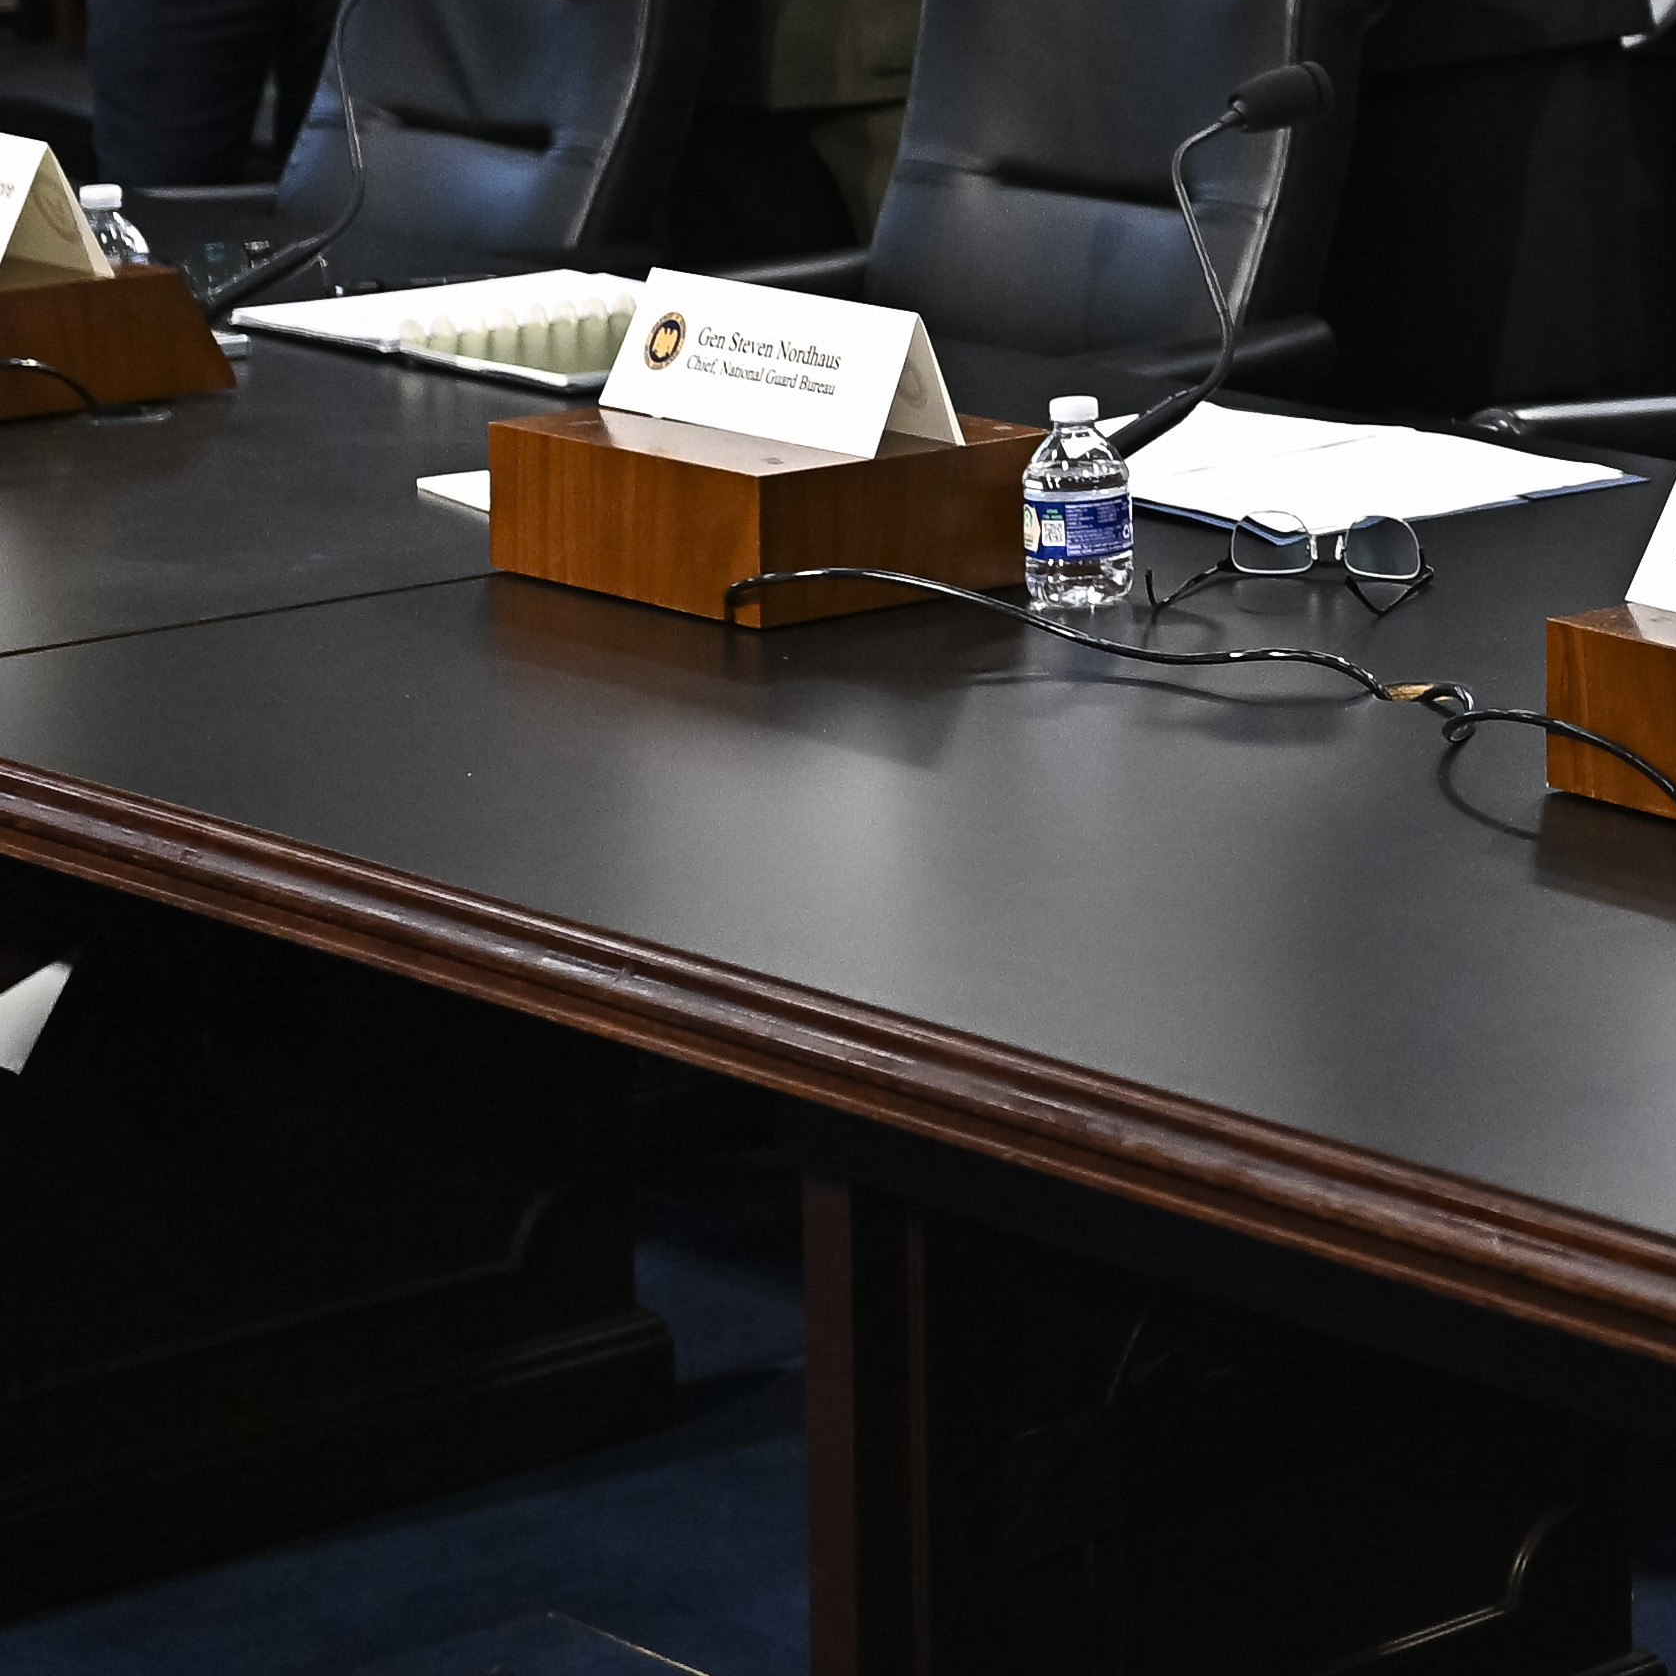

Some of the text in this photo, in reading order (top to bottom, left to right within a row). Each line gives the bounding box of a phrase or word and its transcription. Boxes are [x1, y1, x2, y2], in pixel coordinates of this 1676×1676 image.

[698, 326, 726, 350] Gen
[728, 331, 774, 359] Steven
[776, 339, 842, 371] Nordhaus
[720, 360, 764, 382] National
[765, 369, 799, 389] Guard
[798, 374, 836, 396] Bureau
